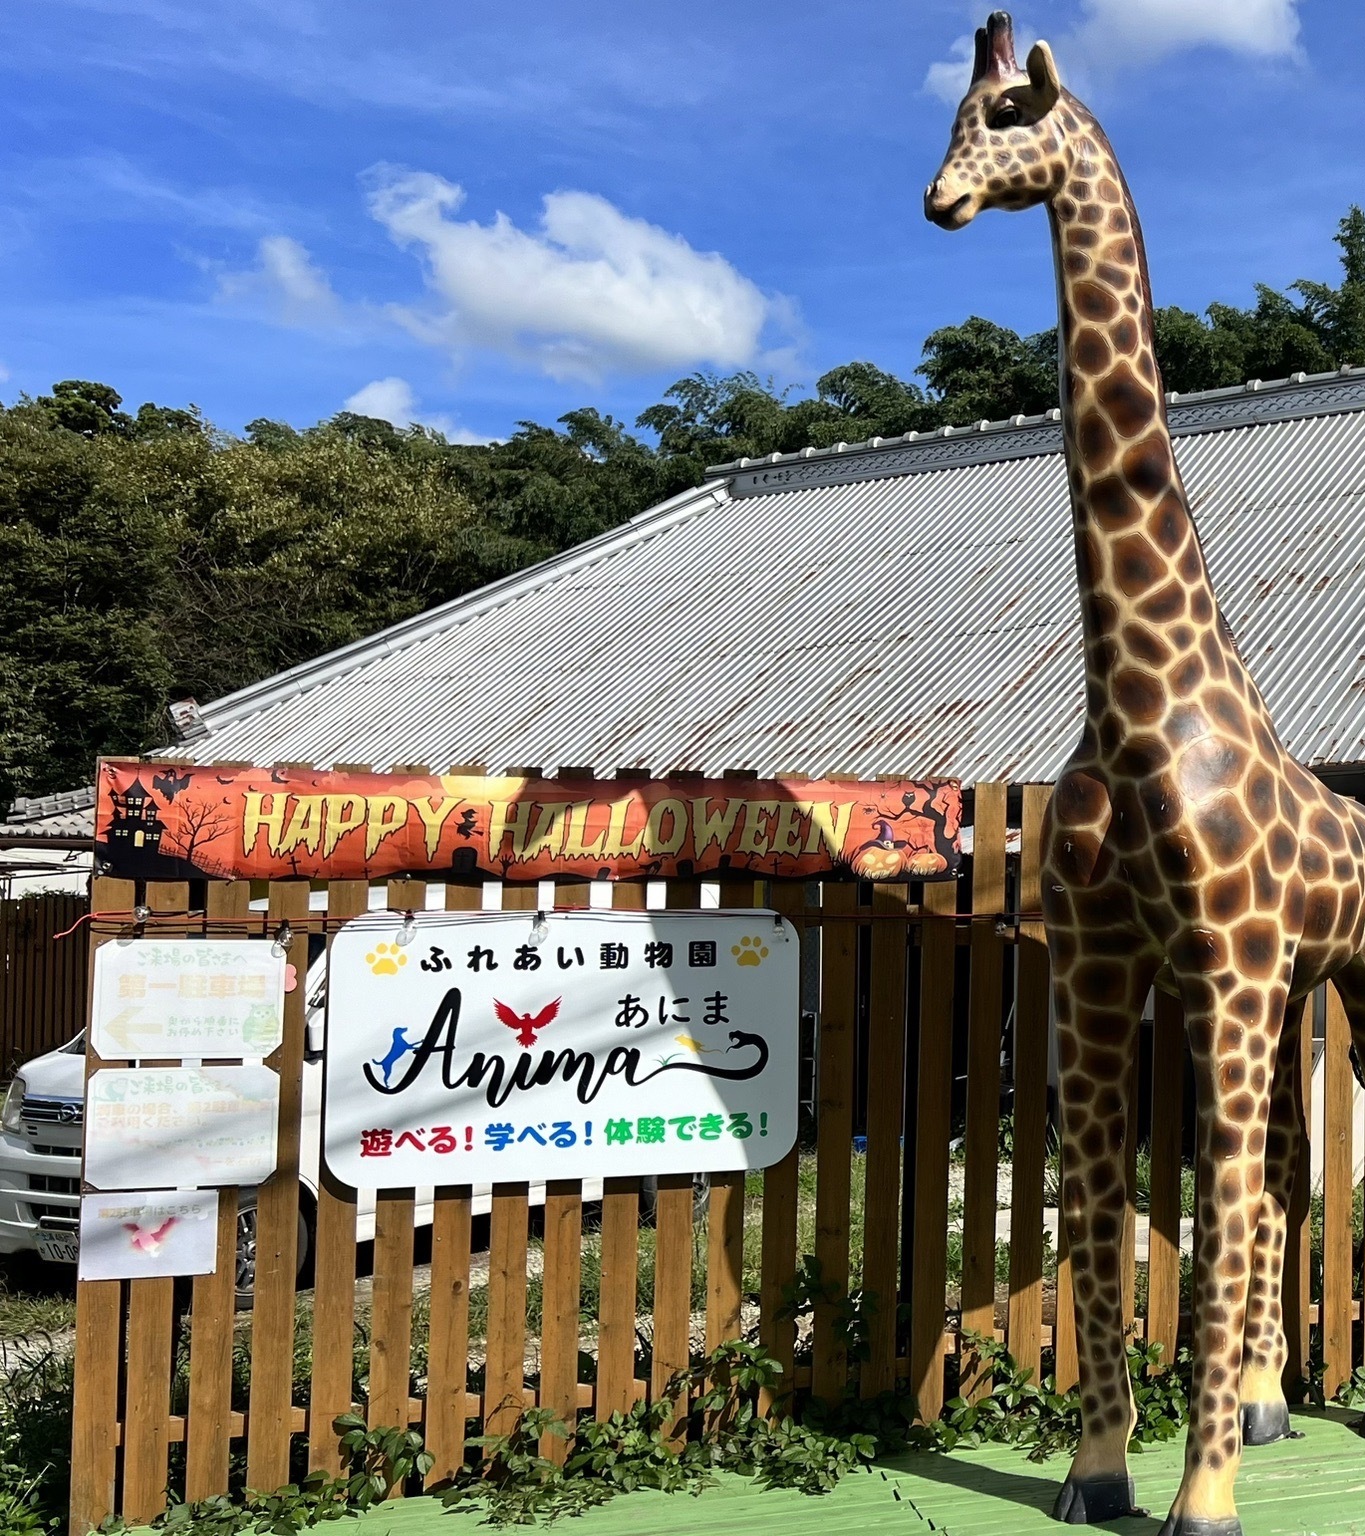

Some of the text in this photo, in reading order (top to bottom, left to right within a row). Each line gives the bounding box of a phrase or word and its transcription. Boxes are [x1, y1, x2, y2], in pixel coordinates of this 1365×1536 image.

[241, 792, 857, 862] HAPPY HALLOWEEN
[420, 941, 717, 973] ふれあい動物園
[614, 991, 731, 1029] あにま
[363, 987, 690, 1108] Anima
